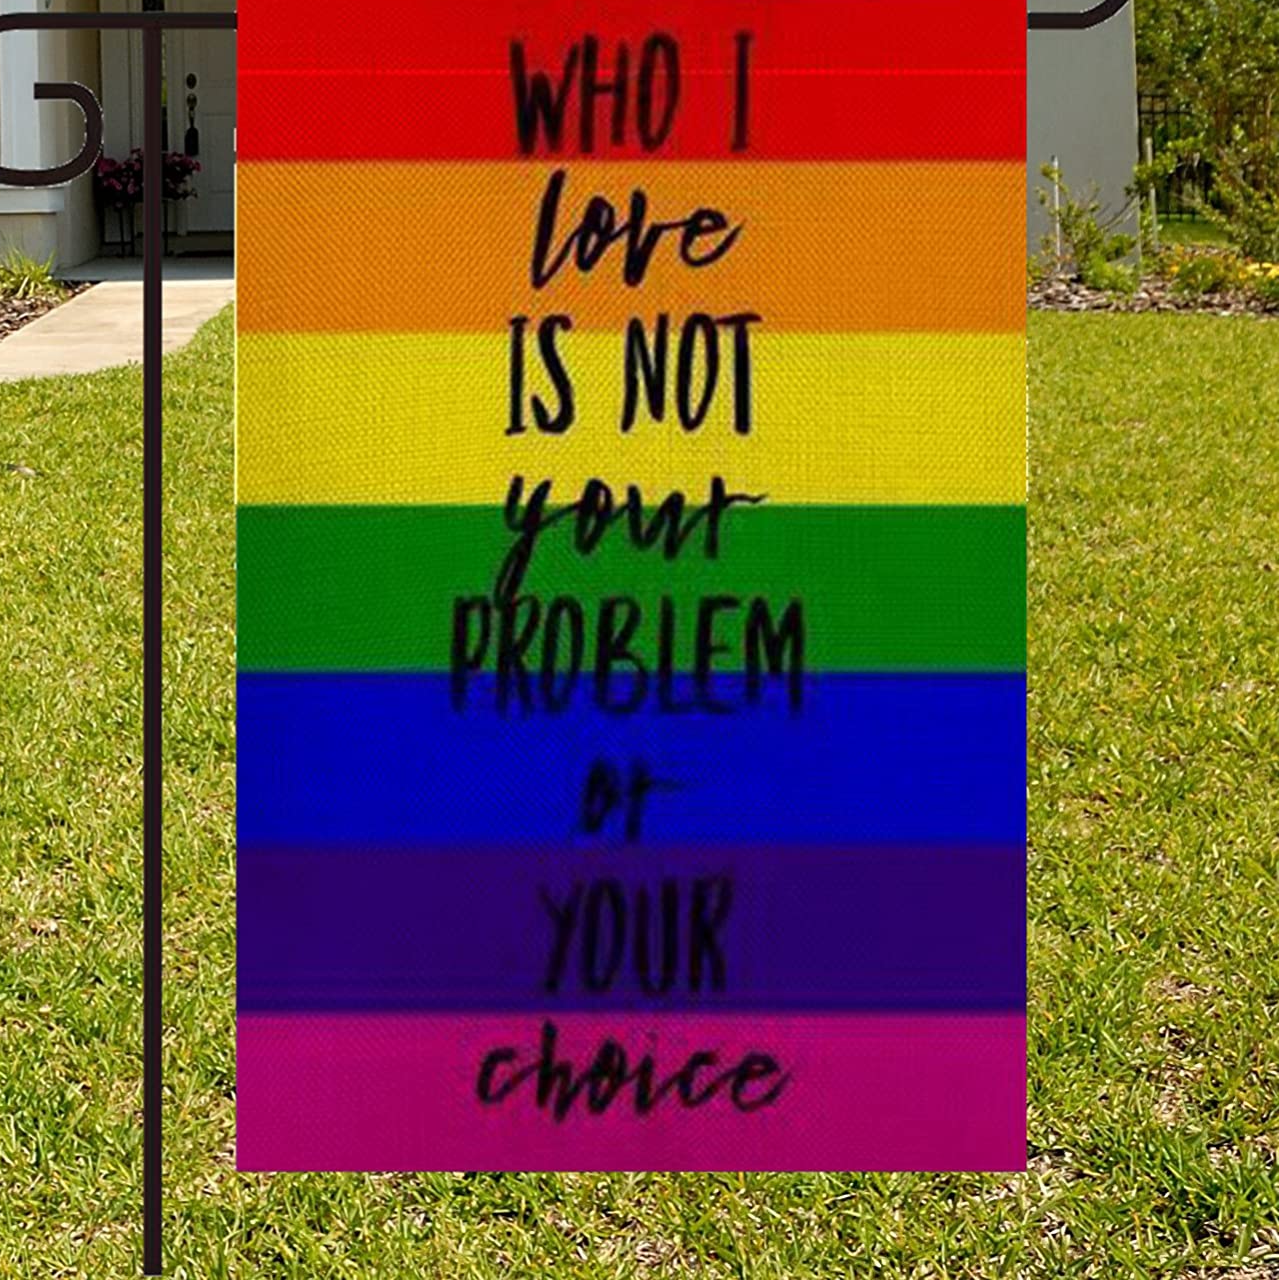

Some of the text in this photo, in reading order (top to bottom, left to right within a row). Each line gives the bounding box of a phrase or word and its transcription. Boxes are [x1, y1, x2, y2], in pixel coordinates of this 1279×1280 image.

[509, 29, 753, 156] WHO I
[531, 169, 745, 291] love
[505, 312, 764, 435] IS NOT
[494, 475, 770, 609] your
[449, 593, 804, 715] PROBLEM
[578, 760, 687, 842] or
[538, 870, 734, 995] YOUR
[476, 1019, 792, 1122] choice
